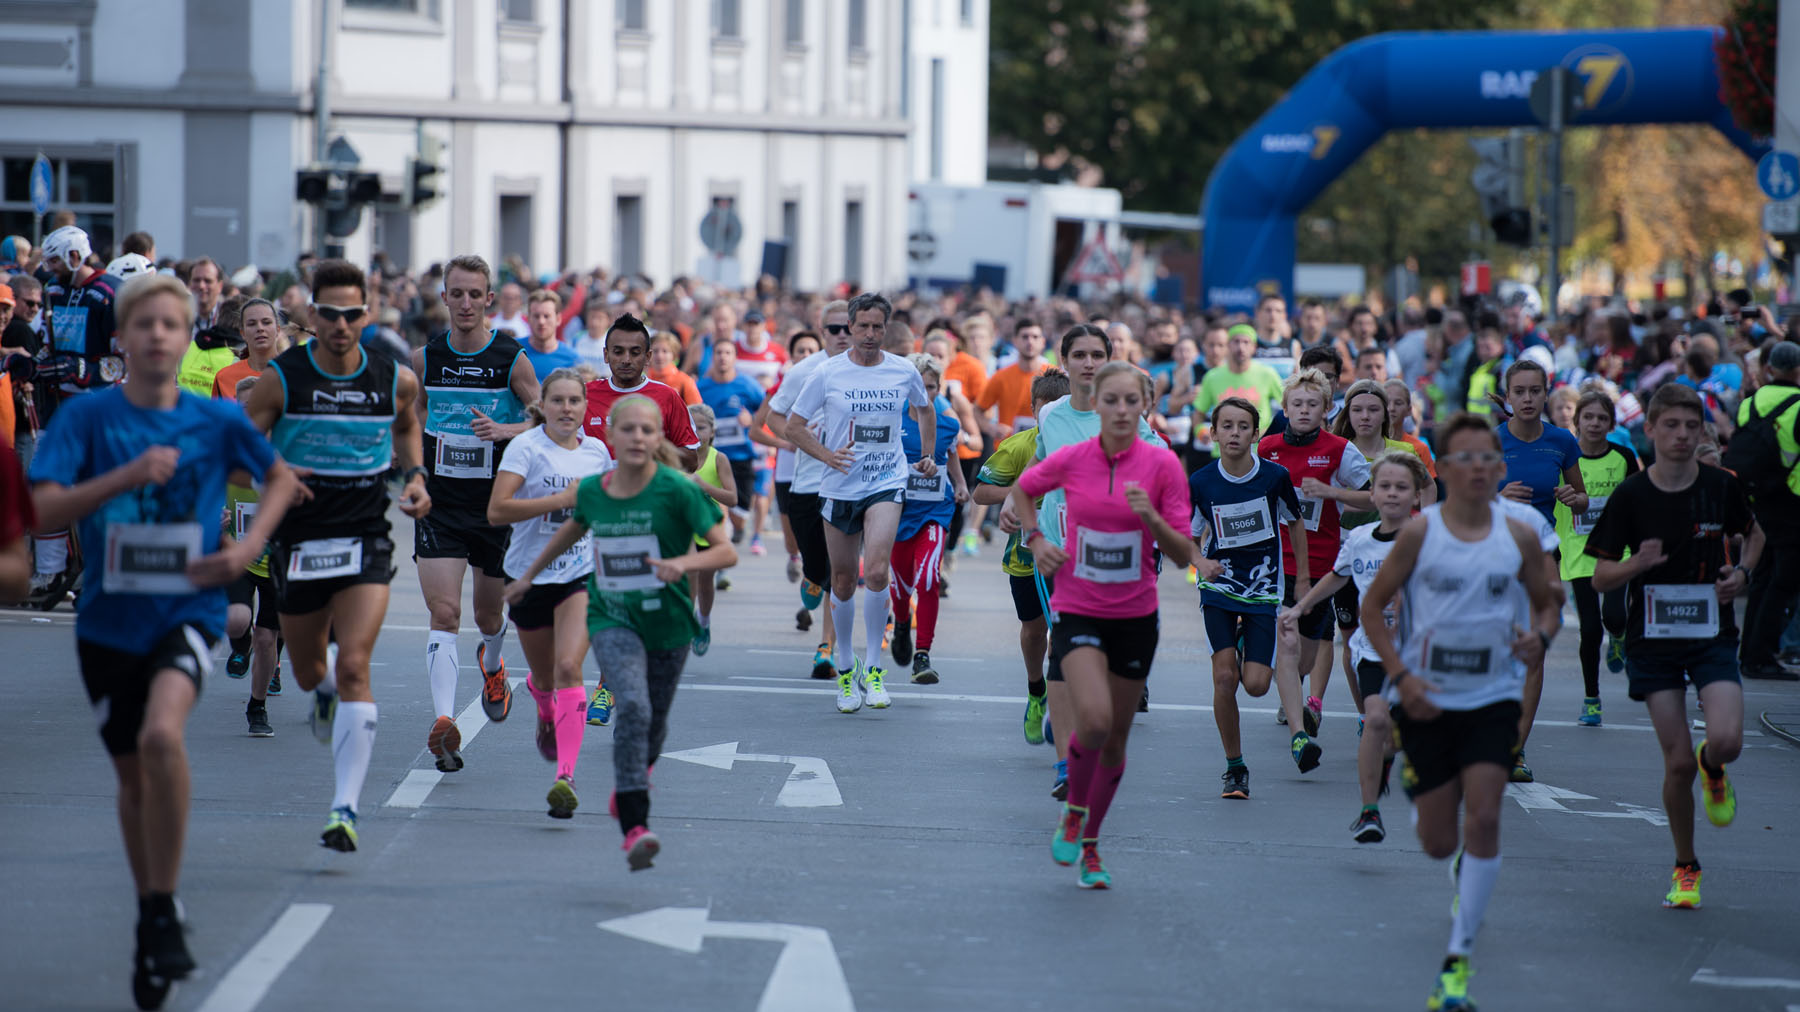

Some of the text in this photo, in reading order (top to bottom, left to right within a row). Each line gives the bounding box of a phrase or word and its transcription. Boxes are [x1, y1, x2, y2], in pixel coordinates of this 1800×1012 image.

[1577, 56, 1625, 109] 7
[442, 366, 494, 378] NR.1
[845, 388, 900, 400] SÜDWEST
[851, 402, 896, 412] PRESSE
[861, 429, 884, 438] 14795
[450, 451, 475, 461] 15311
[543, 474, 576, 489] SÜD
[912, 478, 937, 487] 14045
[1230, 518, 1256, 530] 15066
[1665, 605, 1699, 617] 14922
